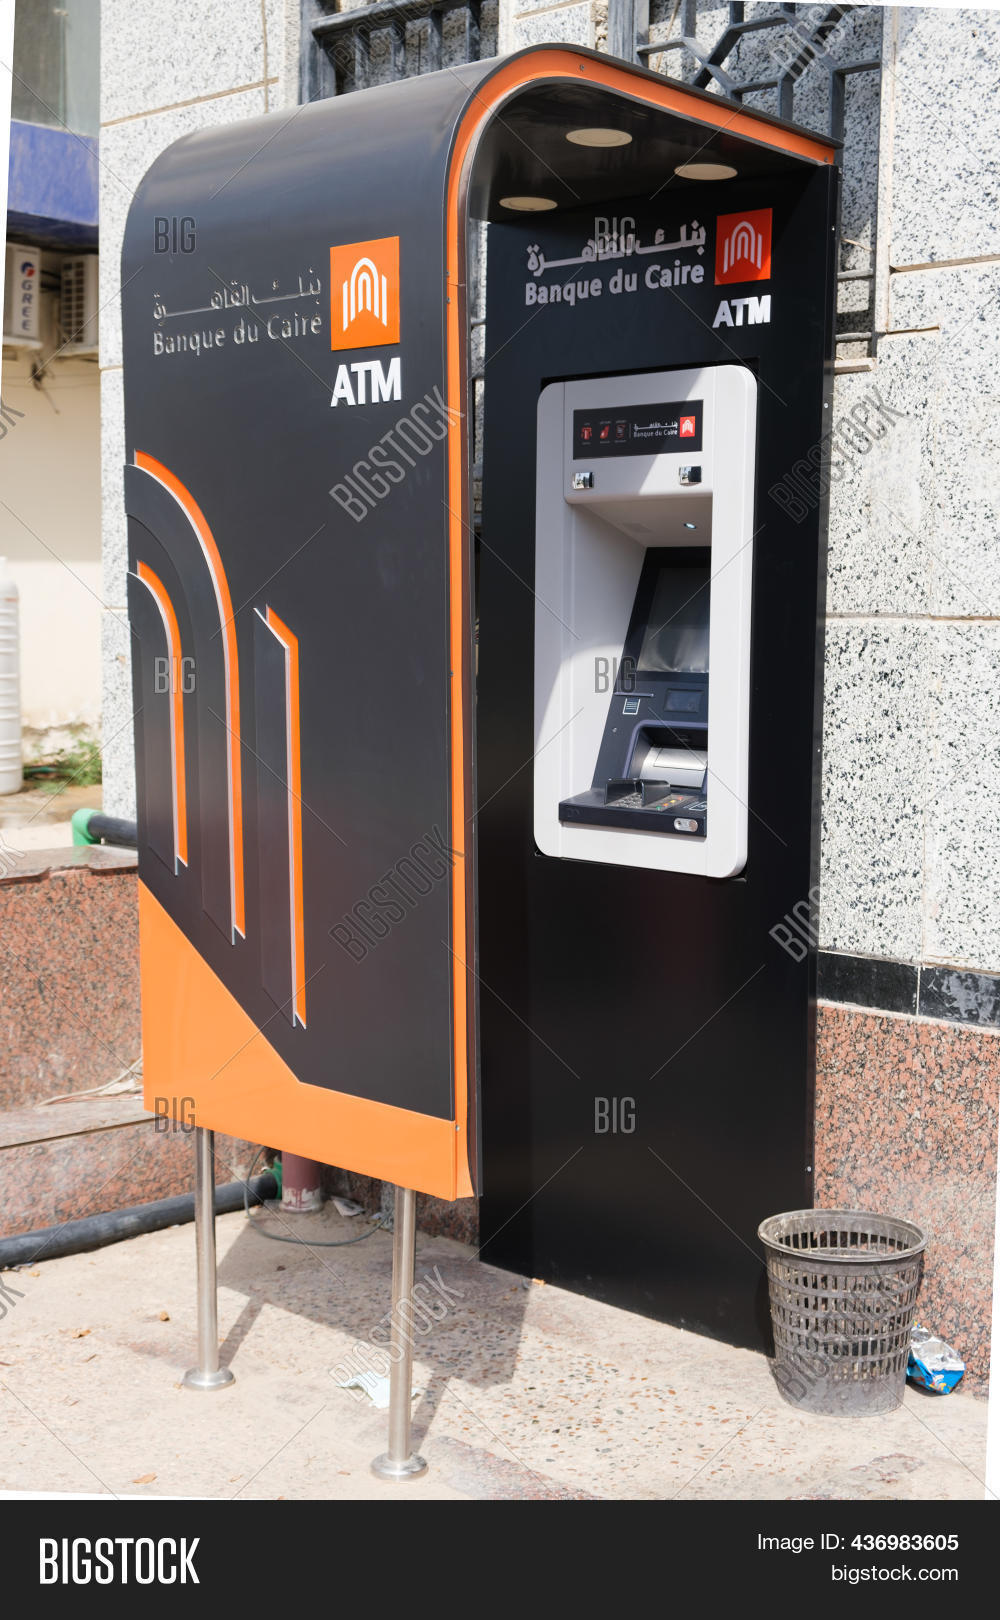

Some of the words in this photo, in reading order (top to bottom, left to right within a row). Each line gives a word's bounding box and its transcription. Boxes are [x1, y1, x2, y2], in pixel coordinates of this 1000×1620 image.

[21, 279, 34, 332] GREE
[525, 274, 603, 307] Banque
[608, 268, 638, 295] du
[644, 259, 705, 289] Caire
[153, 327, 227, 357] Banque
[233, 316, 260, 345] du
[267, 311, 323, 340] Caire
[712, 294, 772, 329] ATM
[330, 357, 402, 408] ATM
